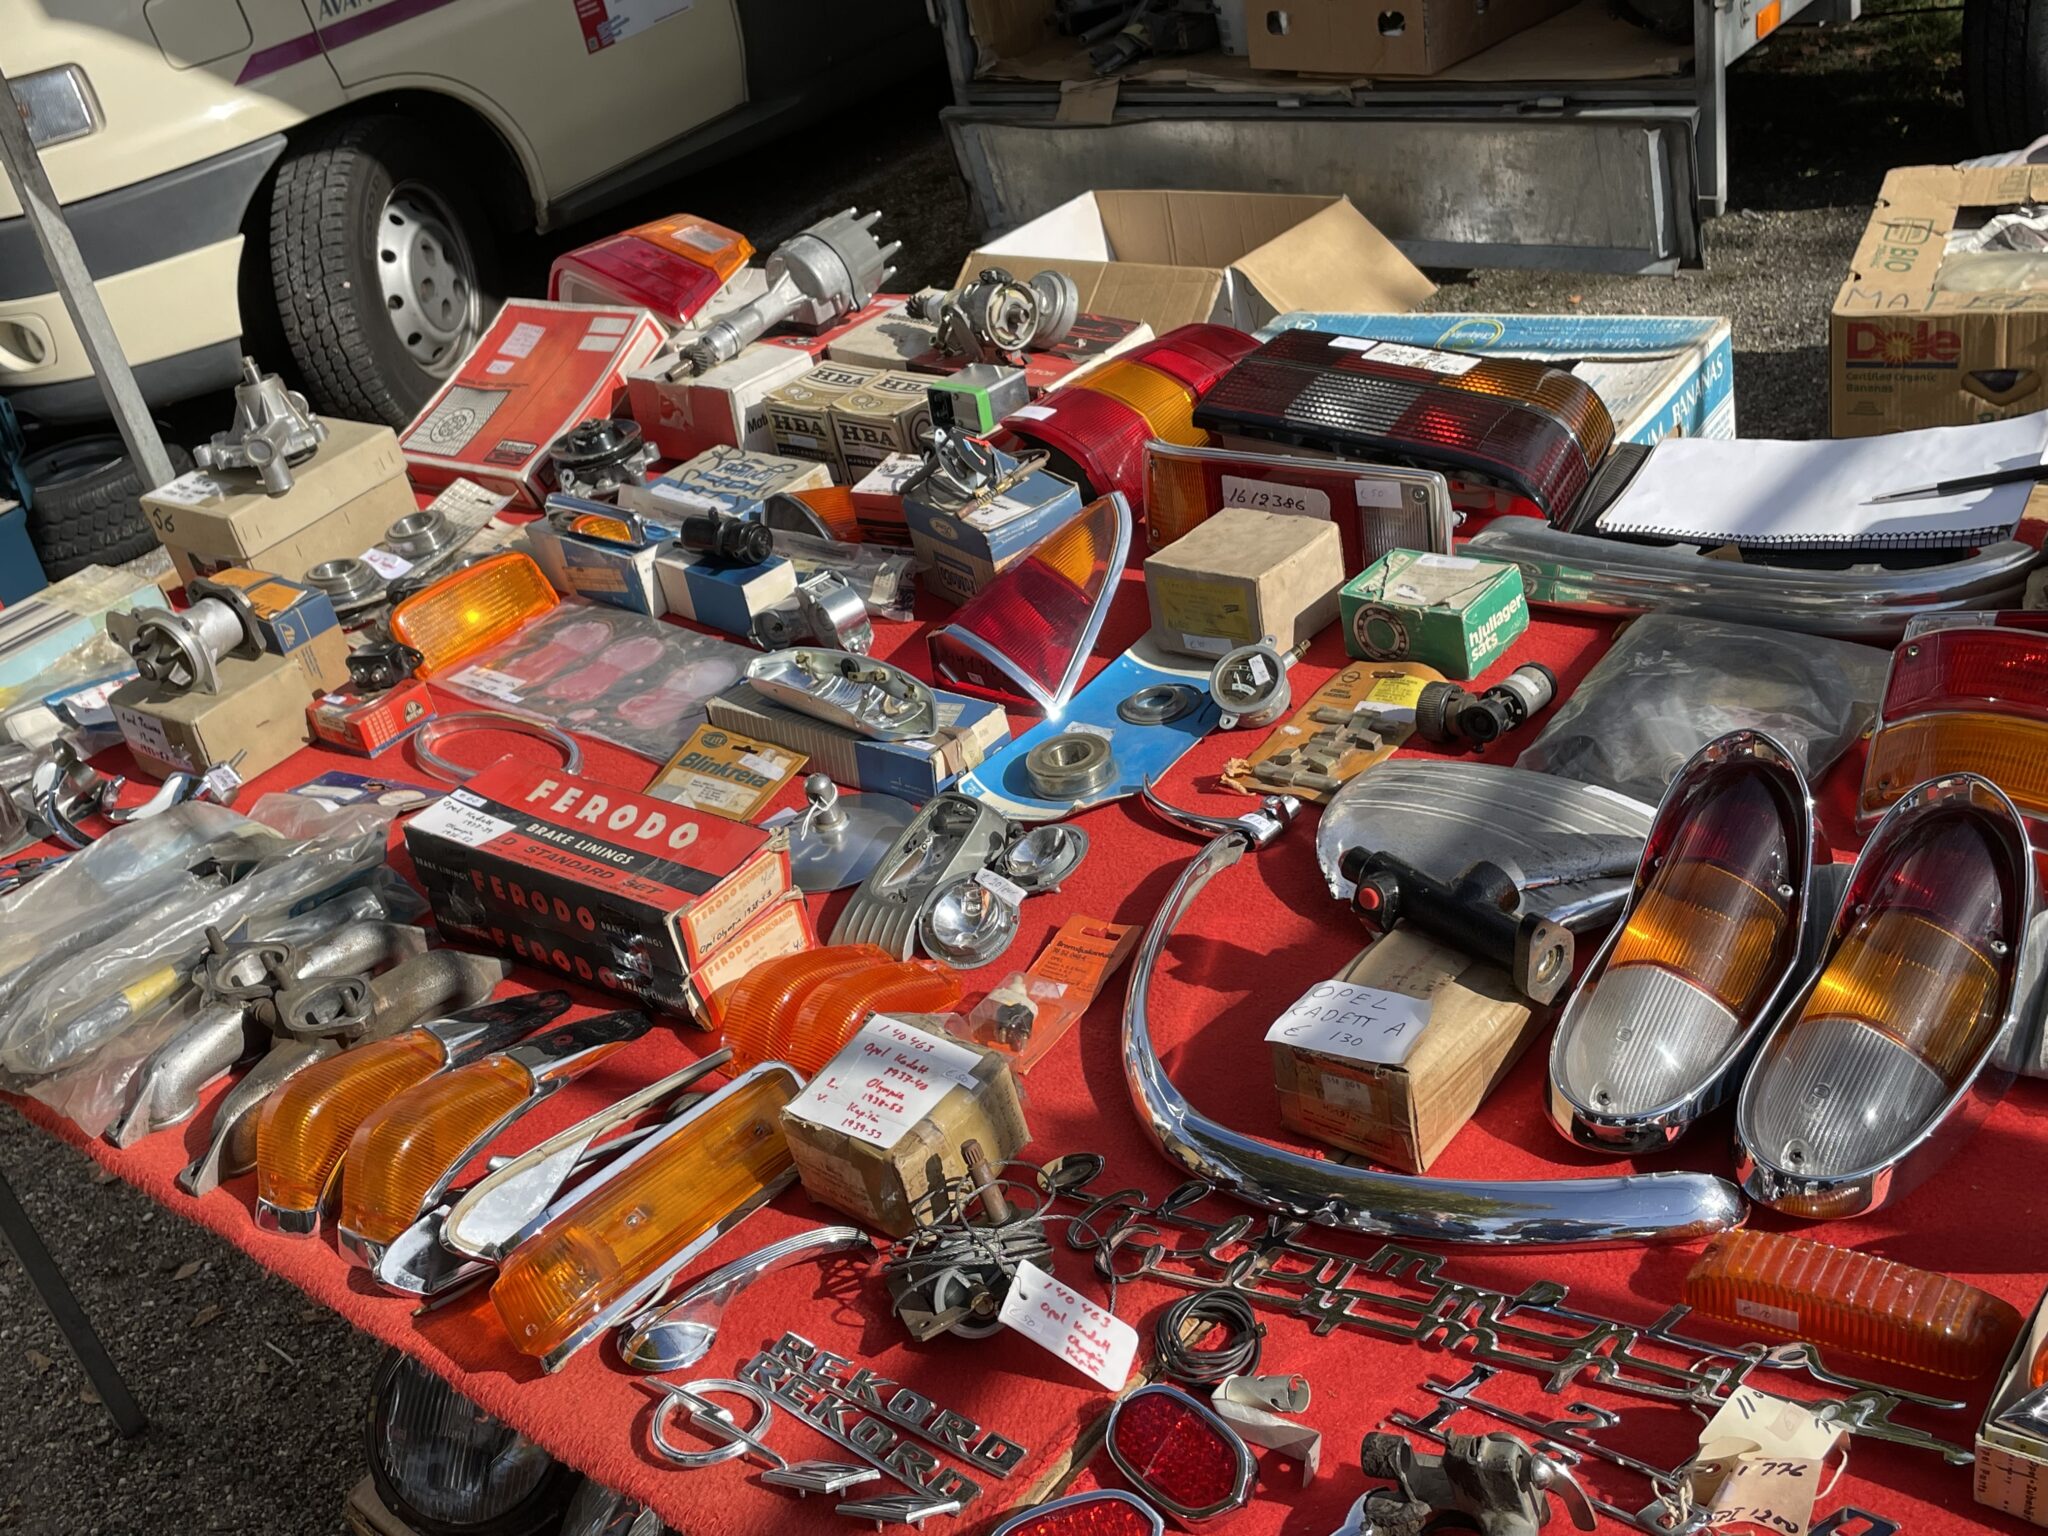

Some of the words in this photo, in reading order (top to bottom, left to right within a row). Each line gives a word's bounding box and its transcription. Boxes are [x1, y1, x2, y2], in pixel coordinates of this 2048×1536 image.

[1846, 320, 1962, 362] Dole
[811, 369, 864, 386] HBA
[1672, 352, 1724, 426] BANANAS
[1846, 383, 1893, 393] Bananas
[1894, 373, 1937, 383] Organic
[772, 414, 827, 437] HBA
[839, 424, 897, 448] HBA
[1469, 593, 1524, 648] hjullager-
[1471, 632, 1499, 661] sats
[525, 779, 699, 849] FERODO
[526, 823, 573, 846] BRAKE
[574, 839, 635, 866] LININGS
[415, 856, 437, 870] BRAKE
[438, 864, 469, 881] LININGS
[523, 845, 616, 880] STANDARD
[621, 877, 665, 894] SET
[470, 869, 596, 931] FERODO
[695, 889, 738, 926] FERODO
[490, 928, 618, 990] FERODO
[709, 940, 751, 977] FERODO
[622, 980, 648, 996] BRAKE
[1312, 986, 1387, 1010] OPEL
[1289, 1003, 1379, 1028] KADETT
[1383, 1022, 1406, 1037] A
[879, 1024, 890, 1032] 1
[892, 1027, 907, 1041] 40
[910, 1036, 936, 1053] 463
[1284, 1024, 1312, 1037] €
[1329, 1031, 1363, 1046] 130
[864, 1042, 888, 1057] Opel
[894, 1053, 930, 1074] Kadett
[866, 1078, 905, 1101] Olympia
[883, 1067, 929, 1091] 1937-40
[861, 1092, 905, 1114] 1938-52
[841, 1117, 883, 1139] 1939-53
[1040, 1302, 1067, 1325] Opel
[1043, 1282, 1053, 1290] 1
[1056, 1287, 1075, 1305] 40
[1081, 1303, 1111, 1328] 463
[771, 1331, 1030, 1479] REKORD
[738, 1351, 983, 1506] REKORD
[1738, 1465, 1748, 1476] 1
[1750, 1508, 1799, 1533] 1200
